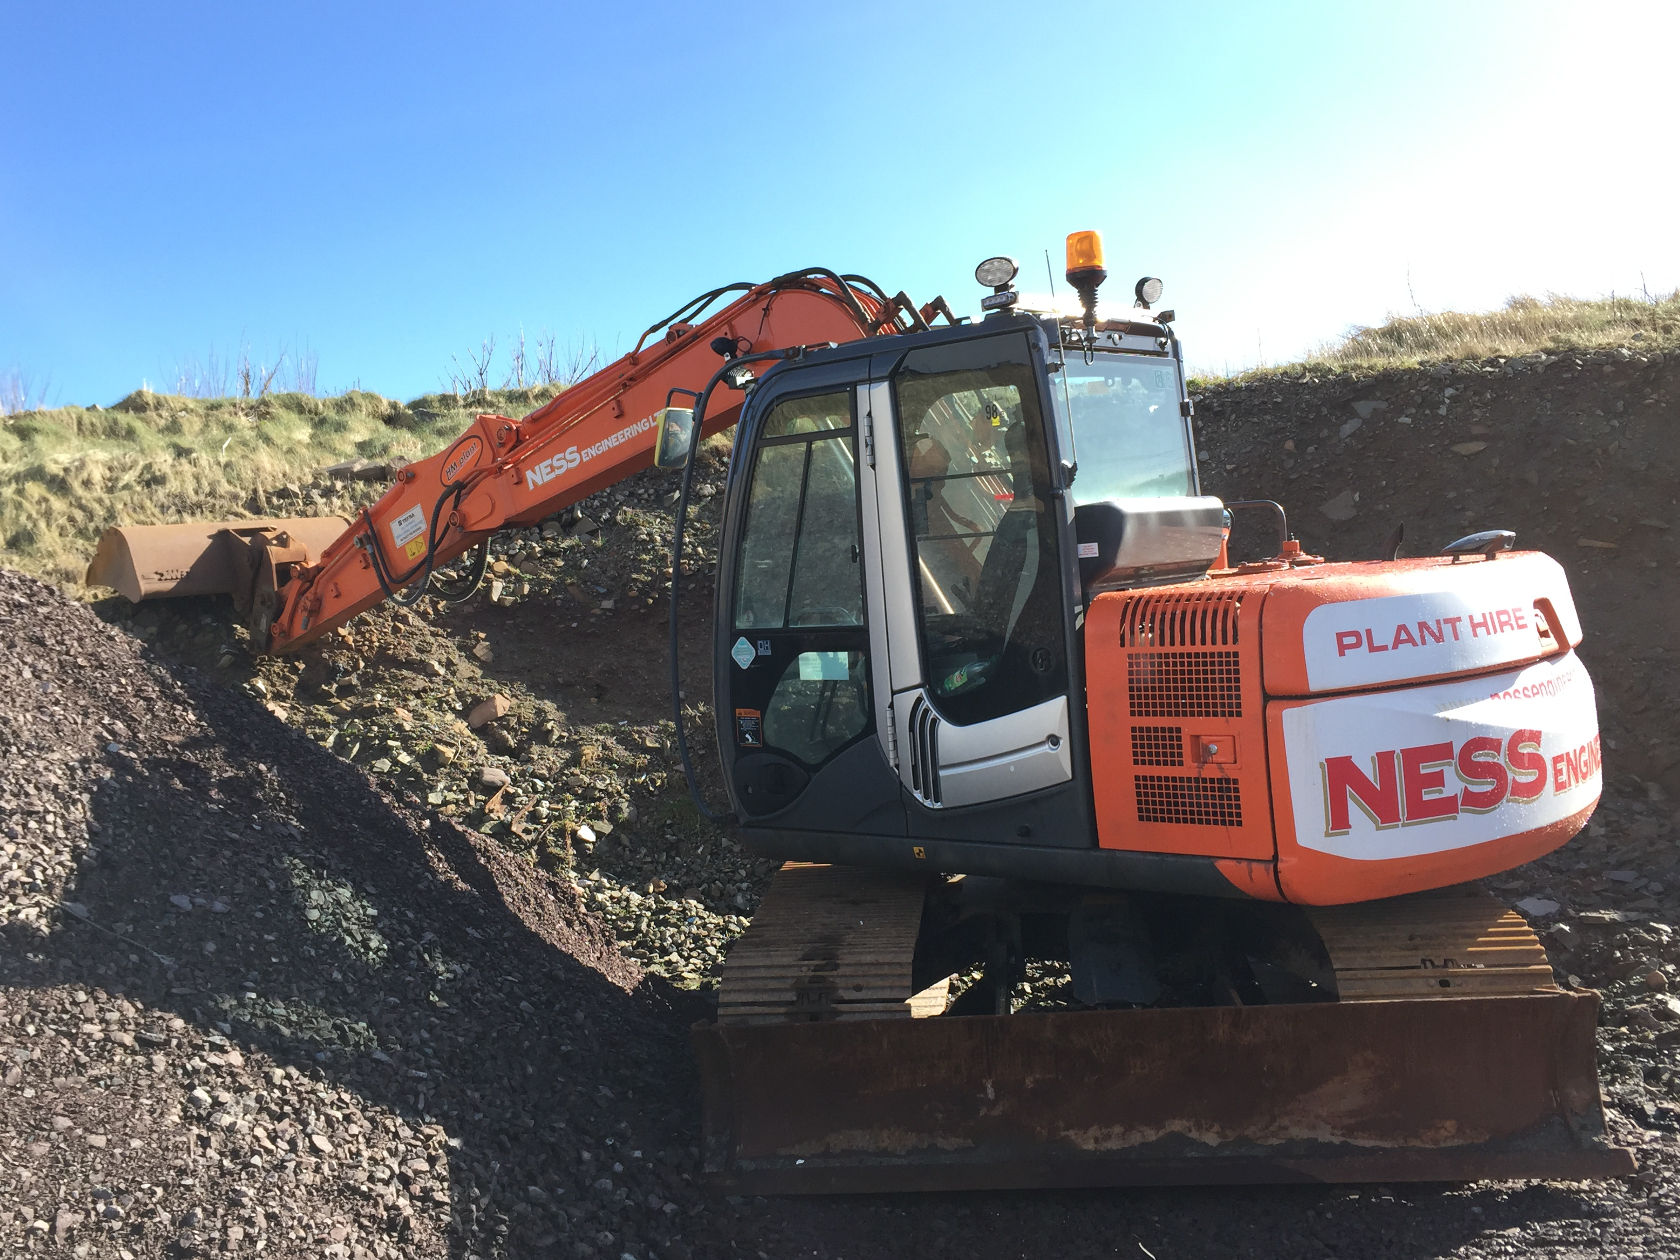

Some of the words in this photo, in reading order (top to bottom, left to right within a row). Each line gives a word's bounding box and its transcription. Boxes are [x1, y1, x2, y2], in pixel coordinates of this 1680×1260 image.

[525, 445, 581, 490] NESS
[581, 418, 649, 462] ENGINEERING
[1335, 616, 1462, 657] PLANT
[1468, 607, 1528, 638] HIRE
[1320, 728, 1548, 837] NESS
